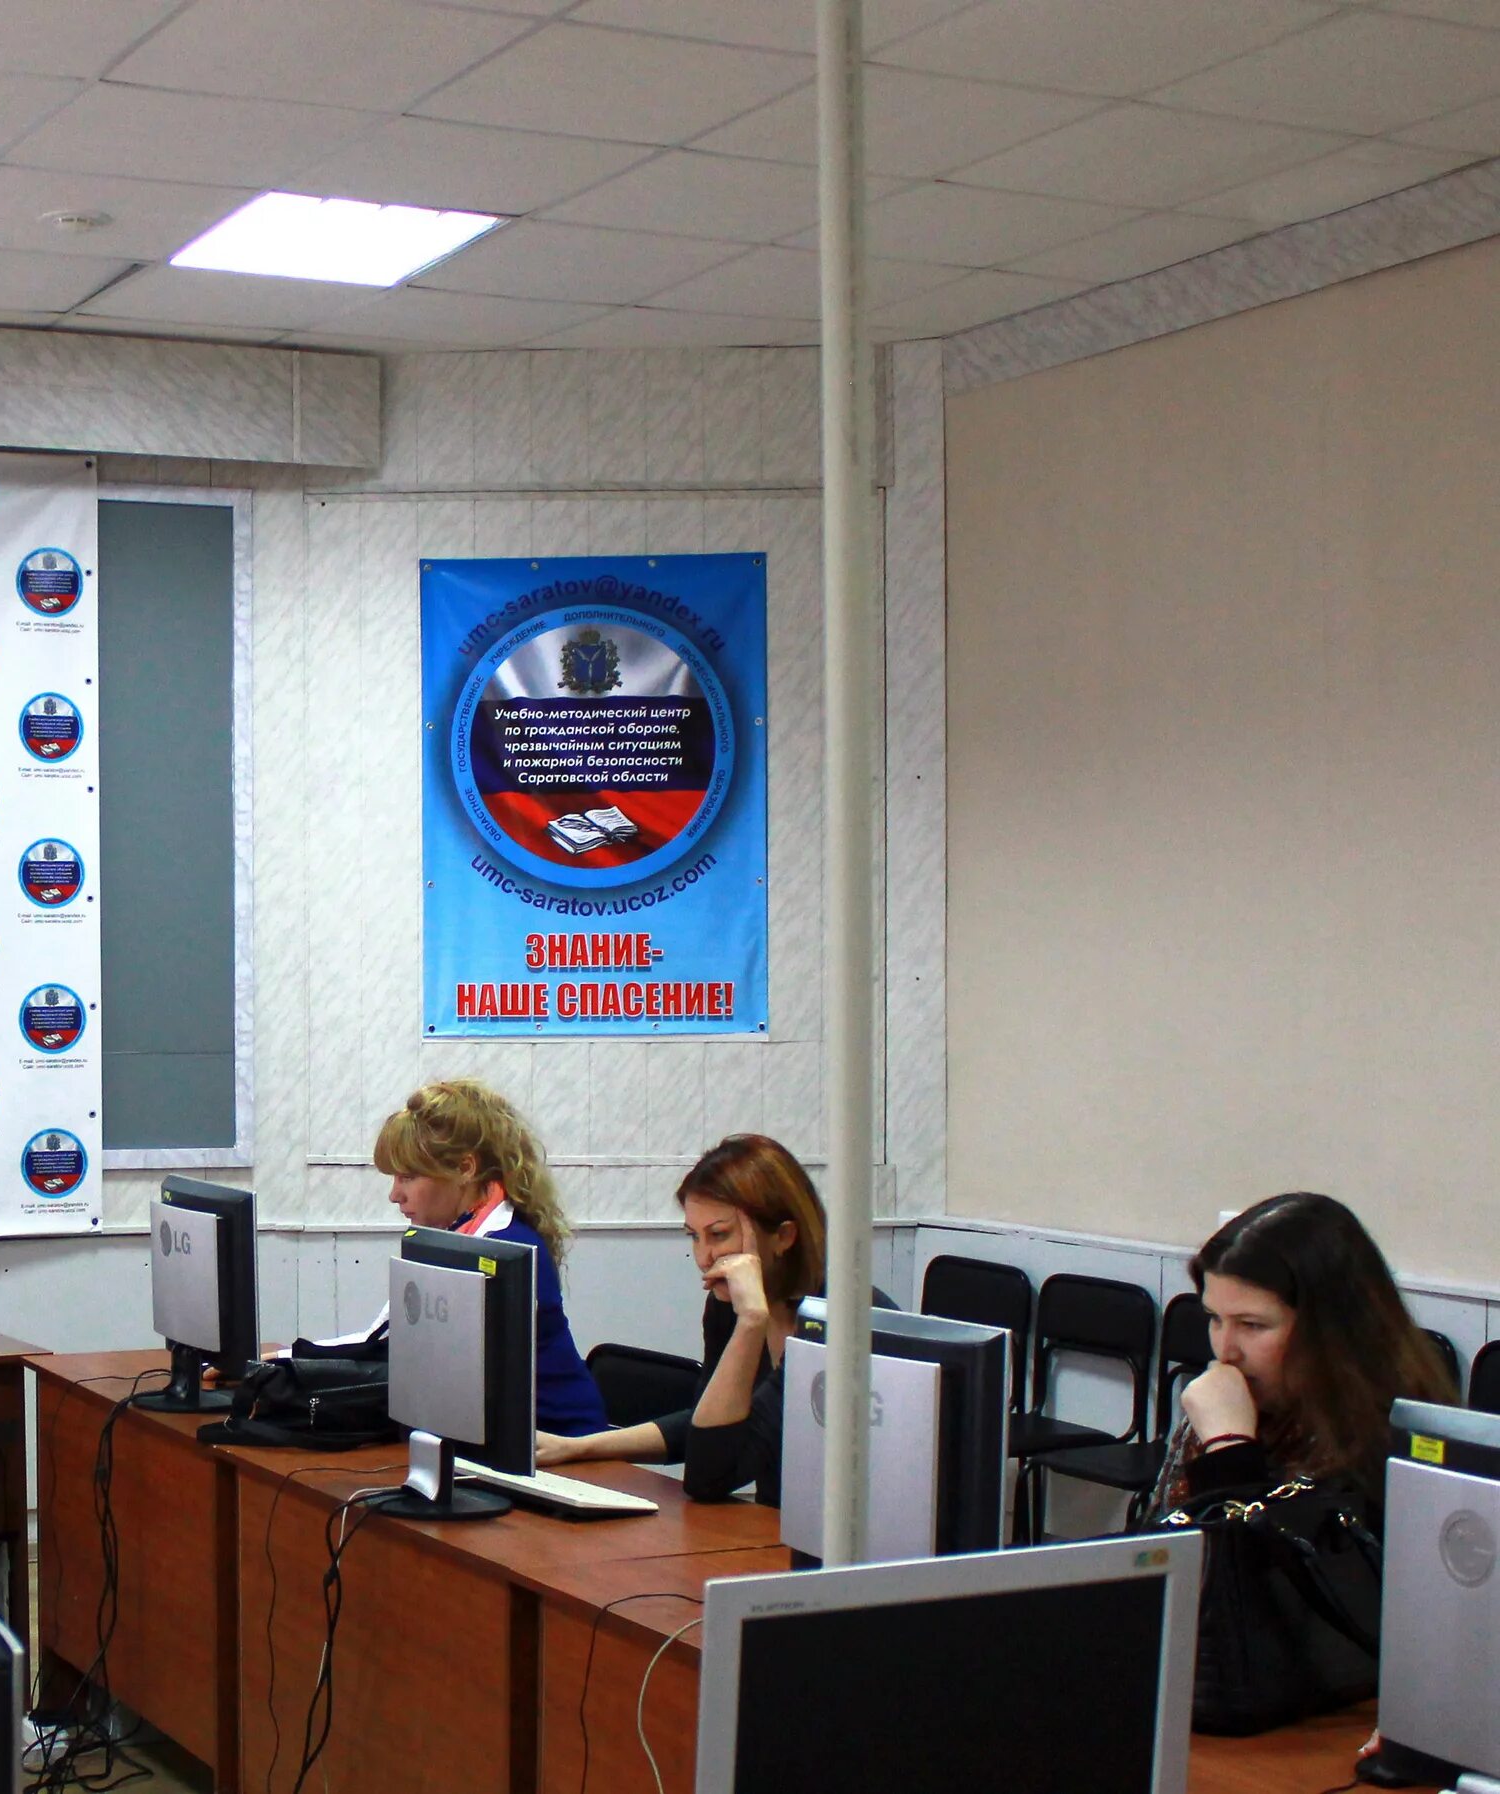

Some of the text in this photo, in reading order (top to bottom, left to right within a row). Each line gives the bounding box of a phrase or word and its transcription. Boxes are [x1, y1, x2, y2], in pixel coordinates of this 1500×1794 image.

[458, 575, 726, 655] umc-saratov@yandex.ru
[564, 610, 666, 638] ДОПОЛНИТЕЛЬНОГО
[488, 620, 547, 665] УЧРЕЖДЕНИЕ
[457, 674, 484, 773] ГОСУДАРСТВЕННОЕ
[494, 706, 691, 720] Учебно-методический центр
[504, 726, 521, 736] по
[524, 723, 615, 737] гражданской
[503, 755, 683, 769] и пожарной безопасности
[504, 740, 681, 754] чрезвычайным ситуациям
[518, 771, 669, 785] Саратовской области
[464, 787, 502, 842] ОБЛАСТНОЕ
[470, 852, 718, 917] umc-saratov.ucoz.com
[525, 933, 664, 970] ЗНАНИЕ-
[456, 982, 735, 1018] НАШЕ СПАСЕНИЕ!
[174, 1231, 191, 1255] LG
[424, 1292, 449, 1323] LG
